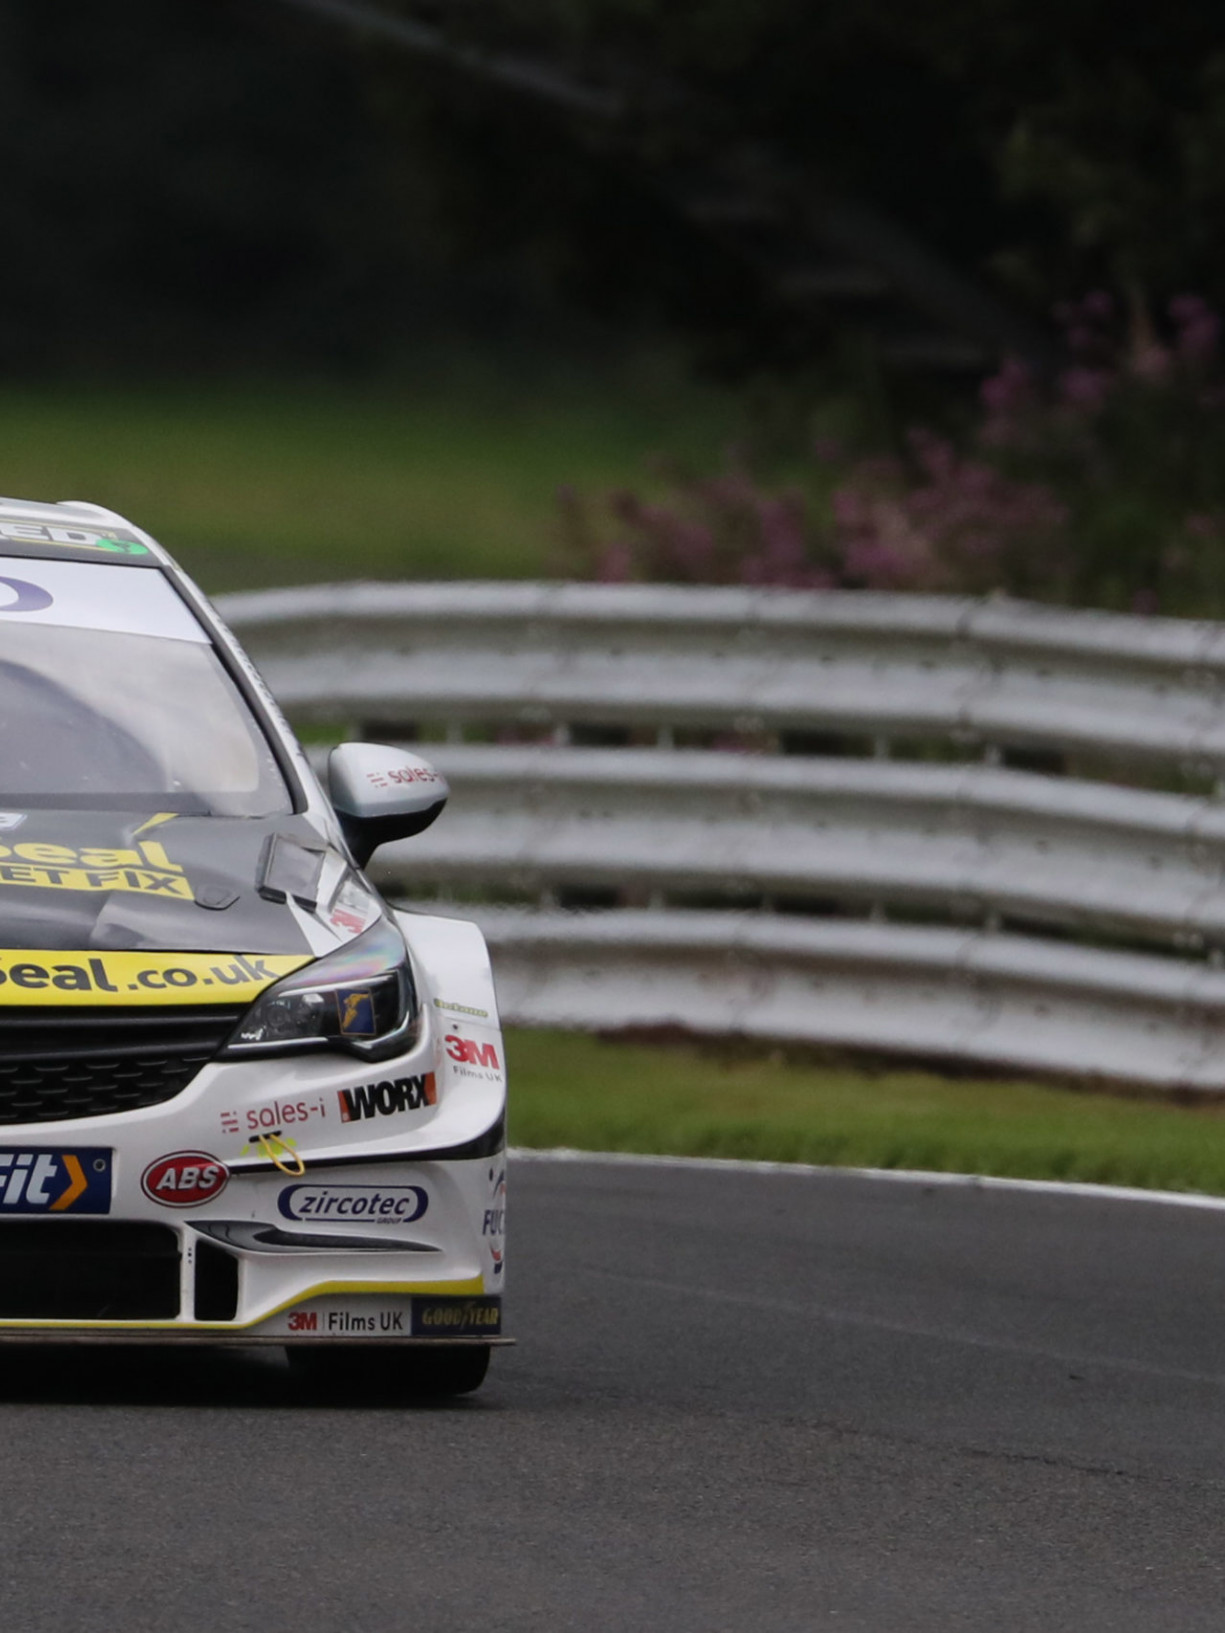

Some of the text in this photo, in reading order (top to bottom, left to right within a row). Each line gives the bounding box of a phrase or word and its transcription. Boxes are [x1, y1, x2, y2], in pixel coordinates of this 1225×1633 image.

[88, 870, 185, 896] FIX
[444, 1034, 500, 1071] 3M
[453, 1065, 503, 1084] Films UK
[342, 1073, 429, 1123] WORX
[246, 1096, 327, 1131] sales-i
[155, 1164, 221, 1191] ABS
[298, 1191, 410, 1216] zircotec
[287, 1311, 403, 1332] 3M Films UK
